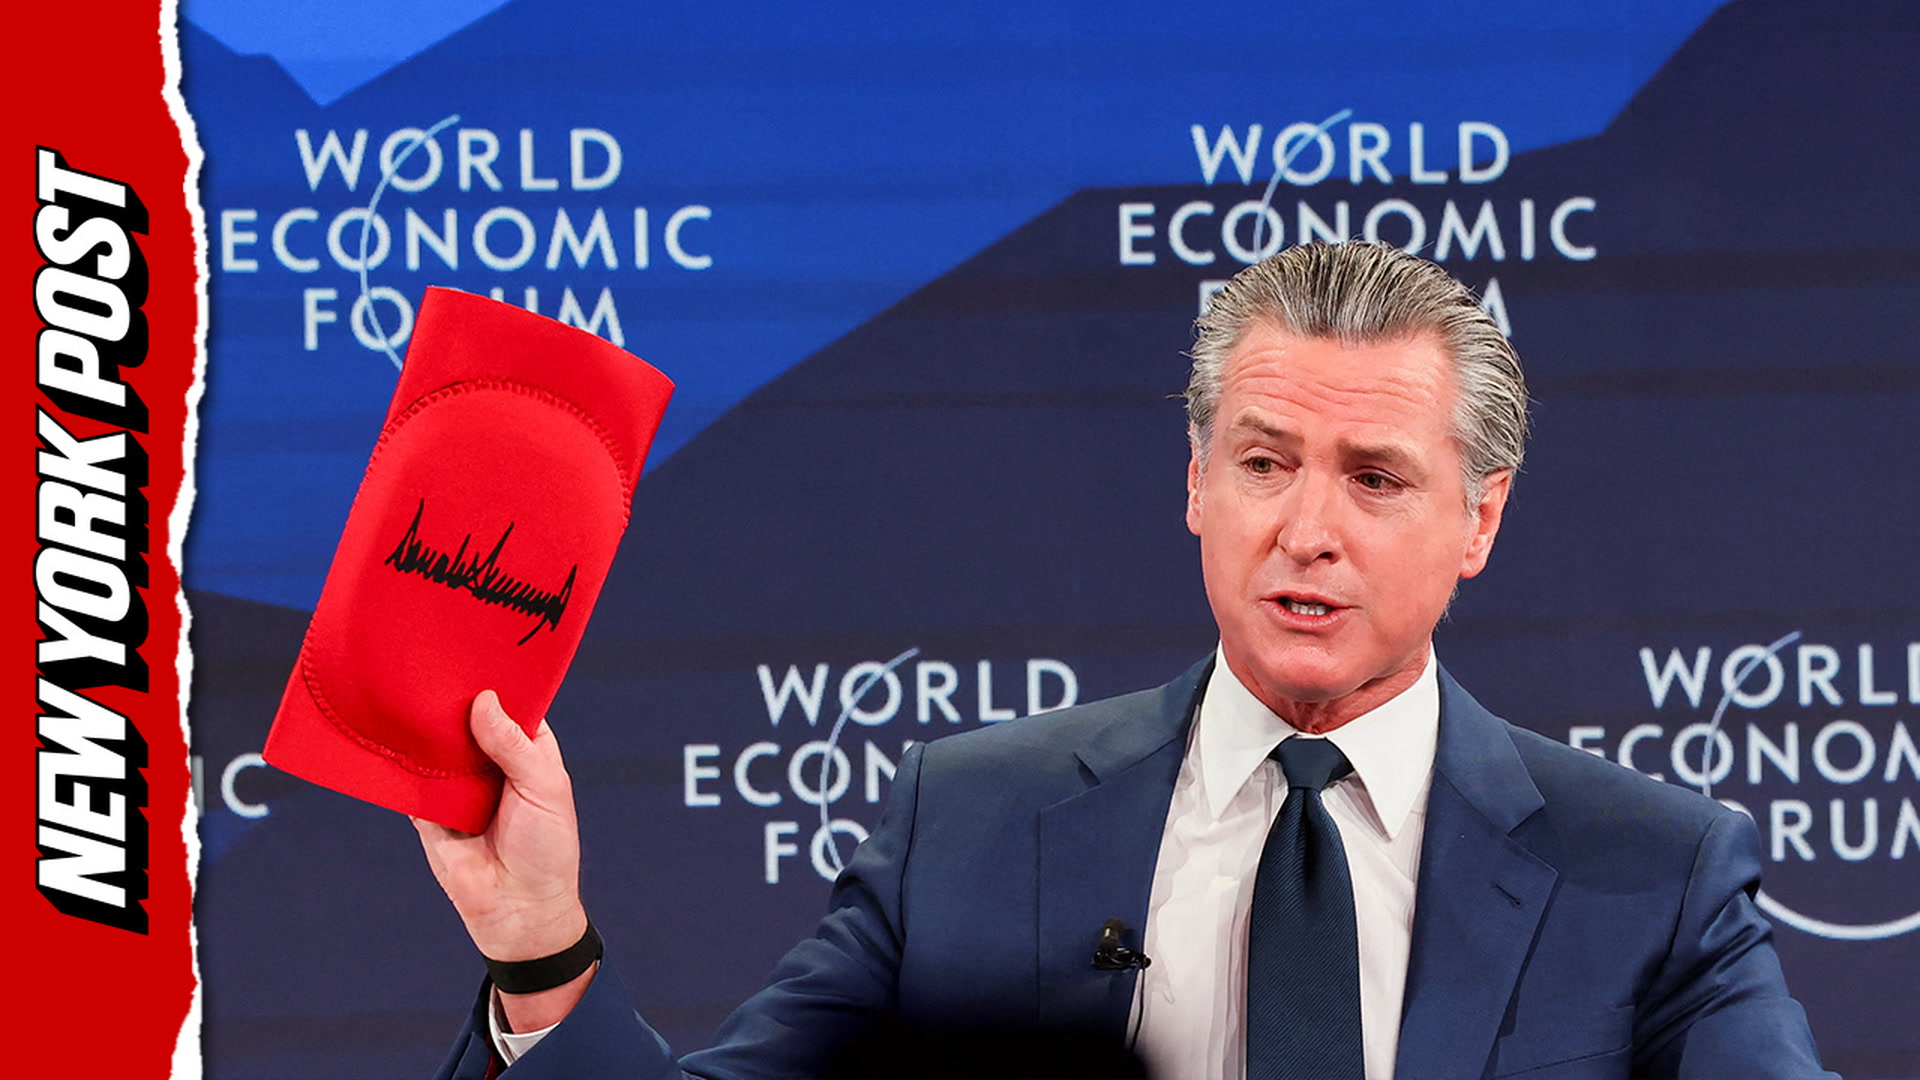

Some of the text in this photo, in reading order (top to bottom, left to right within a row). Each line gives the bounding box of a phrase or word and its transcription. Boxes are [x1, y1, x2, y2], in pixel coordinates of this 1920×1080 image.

[295, 127, 622, 192] WORLD
[1190, 121, 1511, 187] WORLD
[221, 205, 713, 272] ECONOMIC
[1118, 196, 1597, 266] ECONOMIC
[303, 286, 626, 352] FOM
[755, 658, 1080, 728] WORLD
[1638, 643, 1920, 710] WORL
